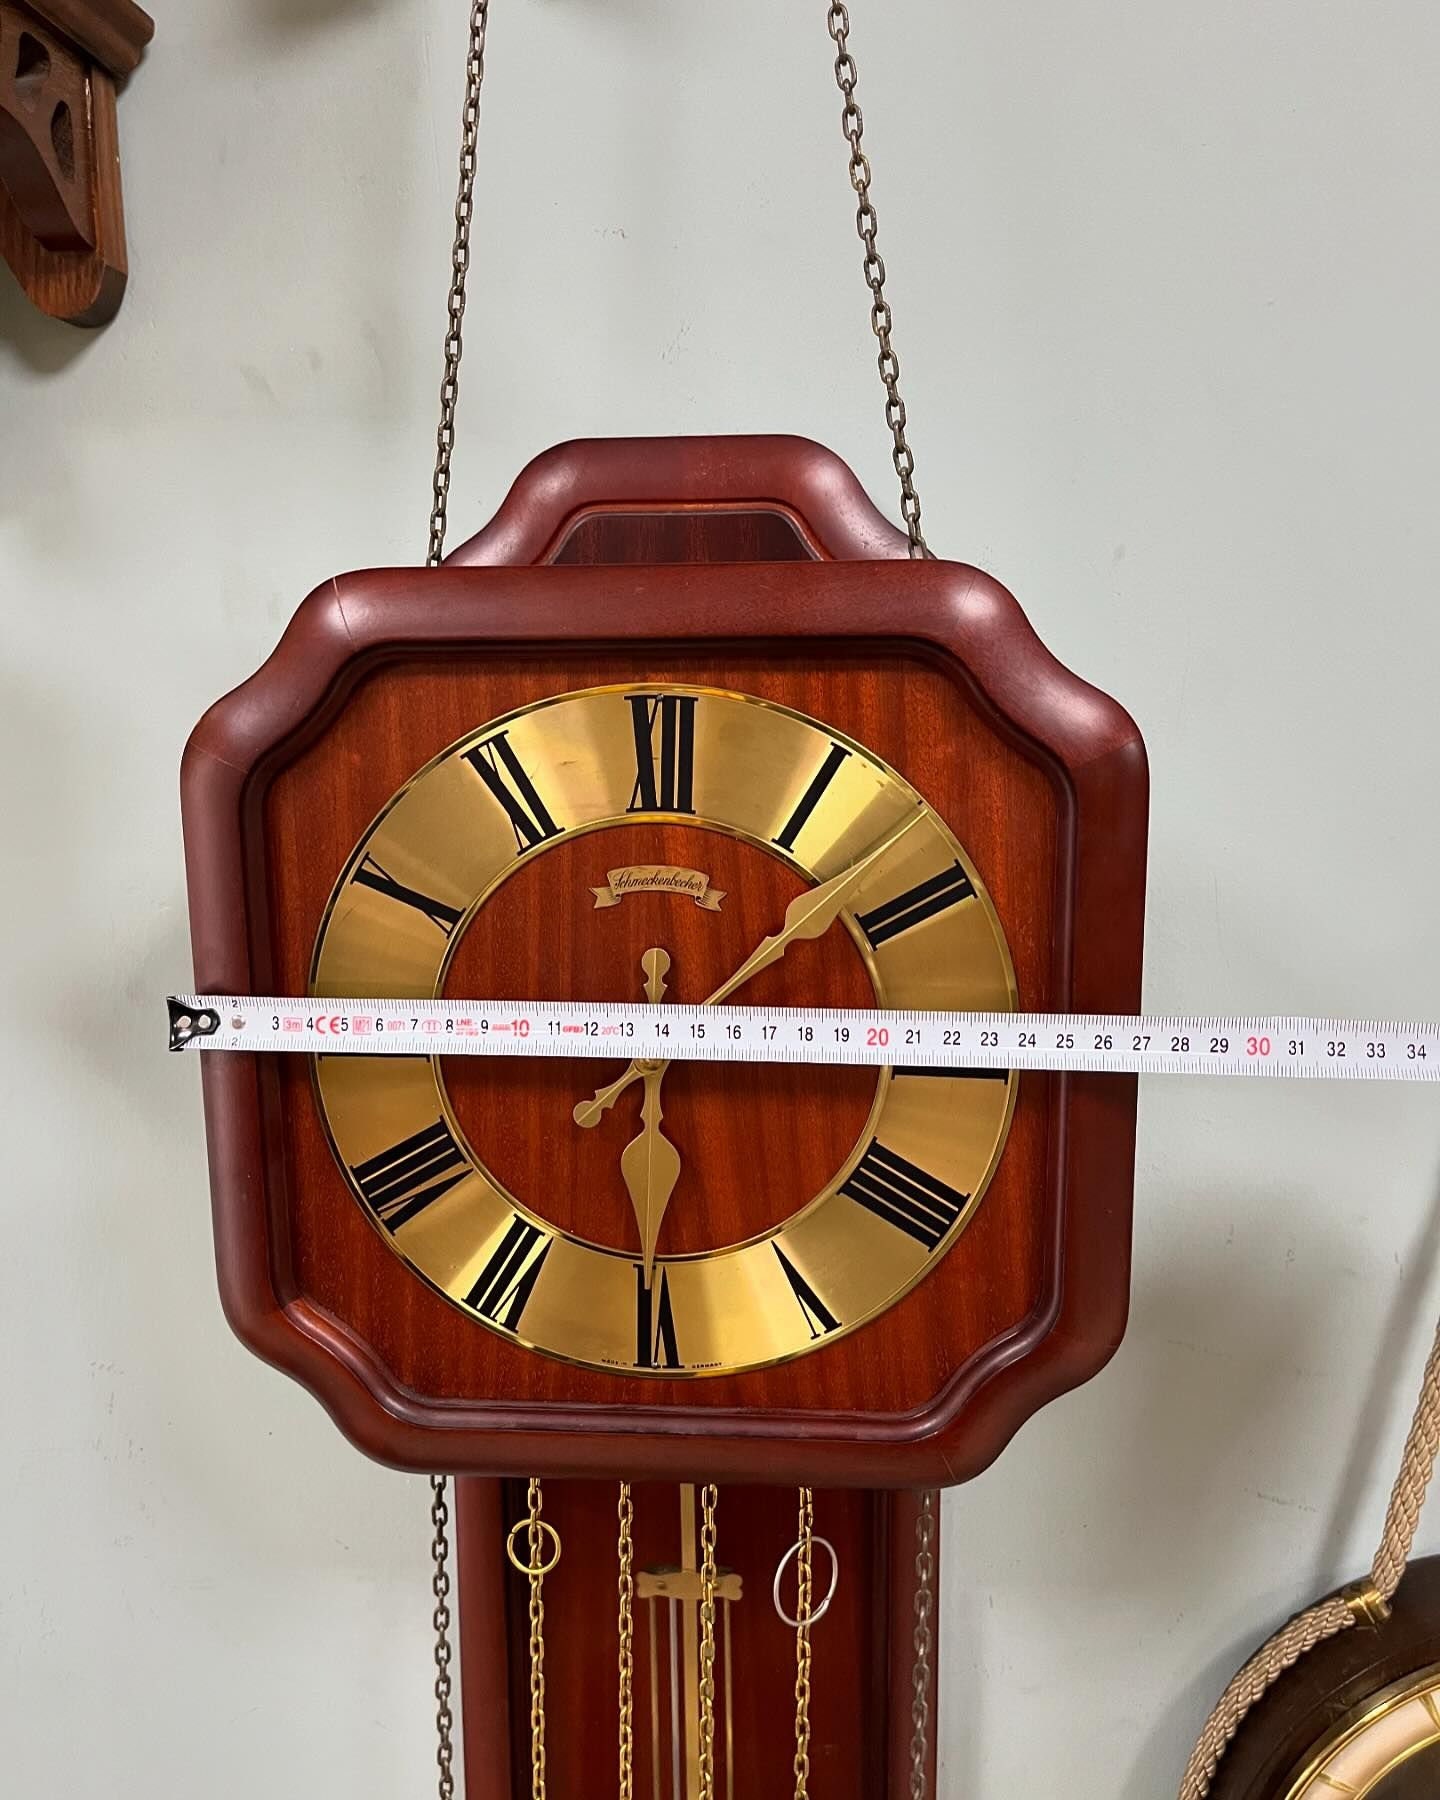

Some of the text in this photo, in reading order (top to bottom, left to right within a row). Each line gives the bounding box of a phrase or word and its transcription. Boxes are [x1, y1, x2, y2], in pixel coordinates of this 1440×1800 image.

[460, 730, 565, 856] XI
[624, 695, 698, 814] XII
[771, 742, 853, 853] I
[350, 852, 466, 939] X
[613, 870, 704, 892] Schmeckenbecher
[855, 859, 978, 951] II
[231, 1000, 239, 1008] 2
[231, 1037, 239, 1046] 2
[272, 1016, 280, 1031] 3
[306, 1016, 314, 1031] 4
[341, 1017, 349, 1031] 5
[376, 1018, 384, 1032] 6
[410, 1018, 419, 1031] 7
[445, 1019, 454, 1034] 8
[481, 1019, 489, 1034] 9
[511, 1019, 530, 1037] 10
[548, 1021, 561, 1036] 11
[583, 1021, 599, 1037] 12
[619, 1021, 634, 1037] 13
[655, 1023, 670, 1038] 14
[690, 1023, 705, 1039] 15
[726, 1024, 742, 1040] 16
[762, 1026, 777, 1041] 17
[797, 1026, 814, 1042] 18
[834, 1027, 850, 1042] 19
[867, 1028, 889, 1047] 20
[905, 1029, 921, 1044] 21
[943, 1030, 961, 1046] 22
[980, 1031, 999, 1047] 23
[1018, 1032, 1037, 1048] 24
[1056, 1034, 1074, 1049] 25
[1094, 1035, 1113, 1050] 26
[1132, 1036, 1151, 1051] 27
[1171, 1037, 1190, 1052] 28
[1209, 1037, 1229, 1053] 29
[1246, 1037, 1271, 1056] 30
[1288, 1040, 1304, 1056] 31
[1327, 1041, 1346, 1057] 32
[1366, 1042, 1386, 1058] 33
[1407, 1044, 1427, 1060] 34
[350, 1114, 474, 1236] VIII
[836, 1136, 971, 1253] IIII
[461, 1213, 554, 1334] VII
[633, 1263, 685, 1369] VI
[770, 1240, 843, 1340] V
